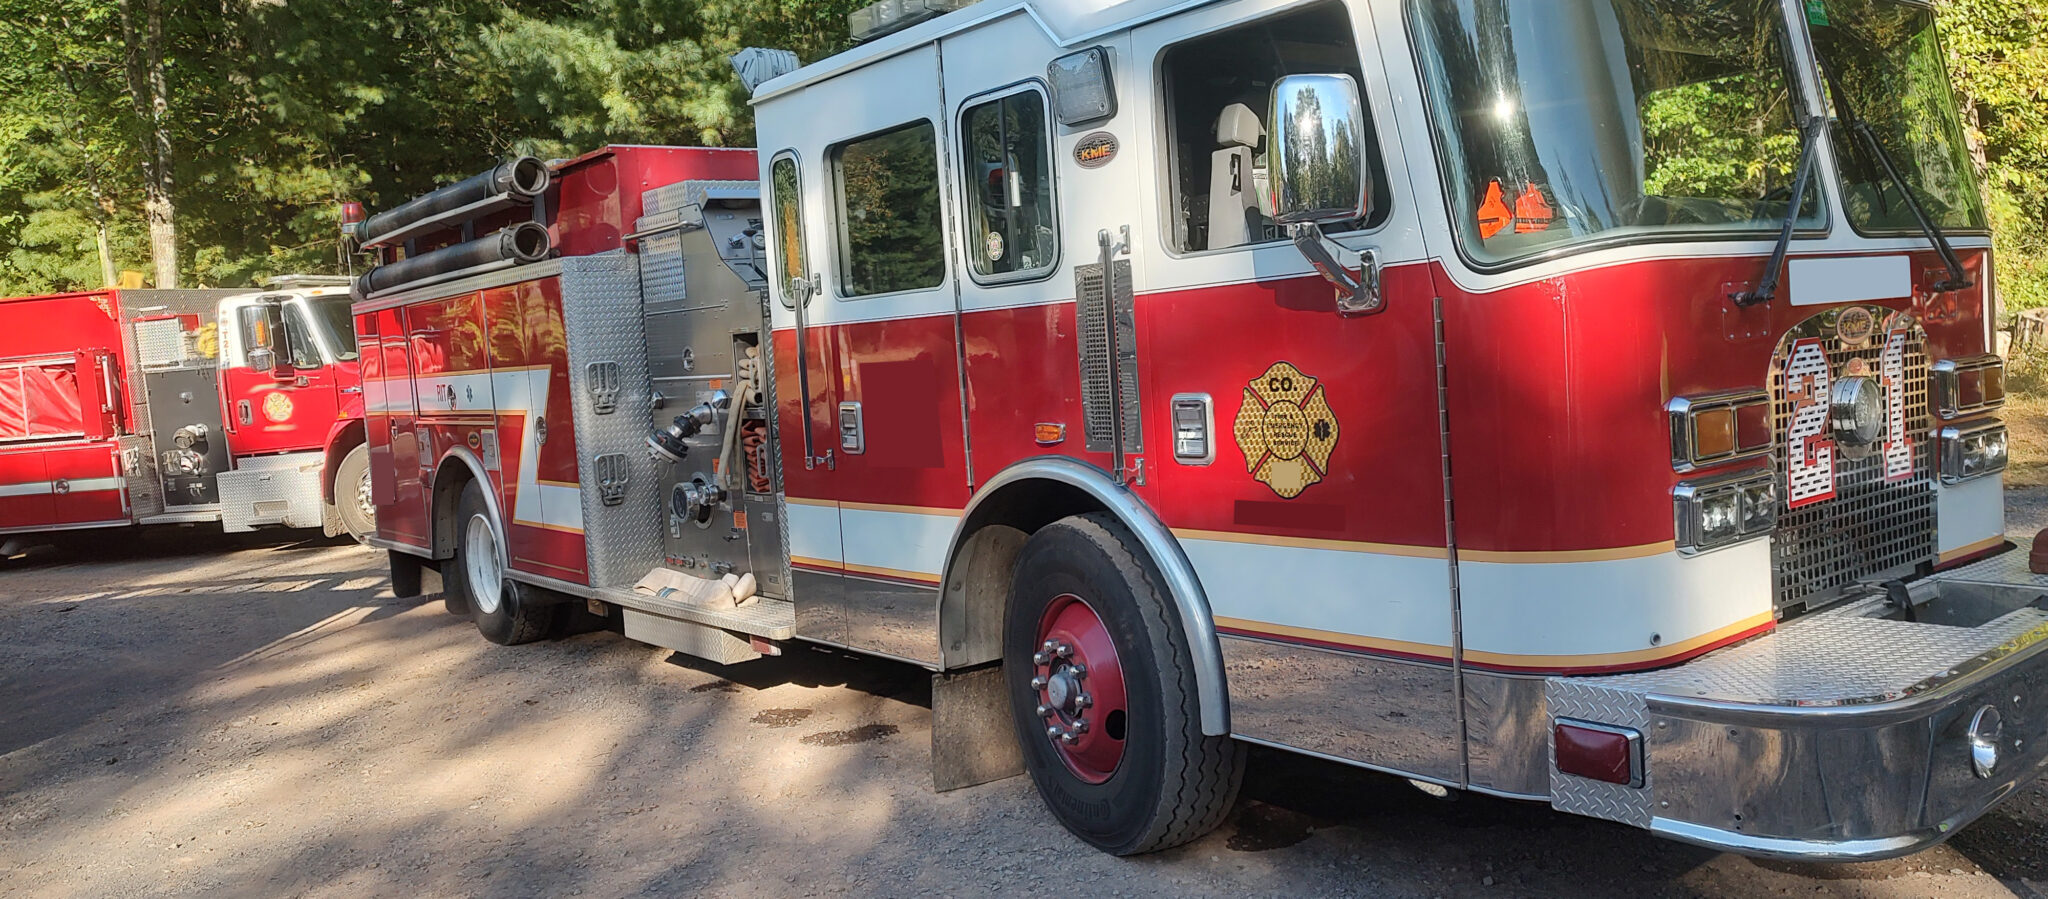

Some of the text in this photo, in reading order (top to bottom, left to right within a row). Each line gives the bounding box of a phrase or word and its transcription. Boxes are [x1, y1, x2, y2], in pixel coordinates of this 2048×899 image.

[1081, 144, 1111, 160] KME
[1844, 320, 1867, 333] KME
[1269, 377, 1297, 391] CO.
[436, 384, 446, 402] RIT
